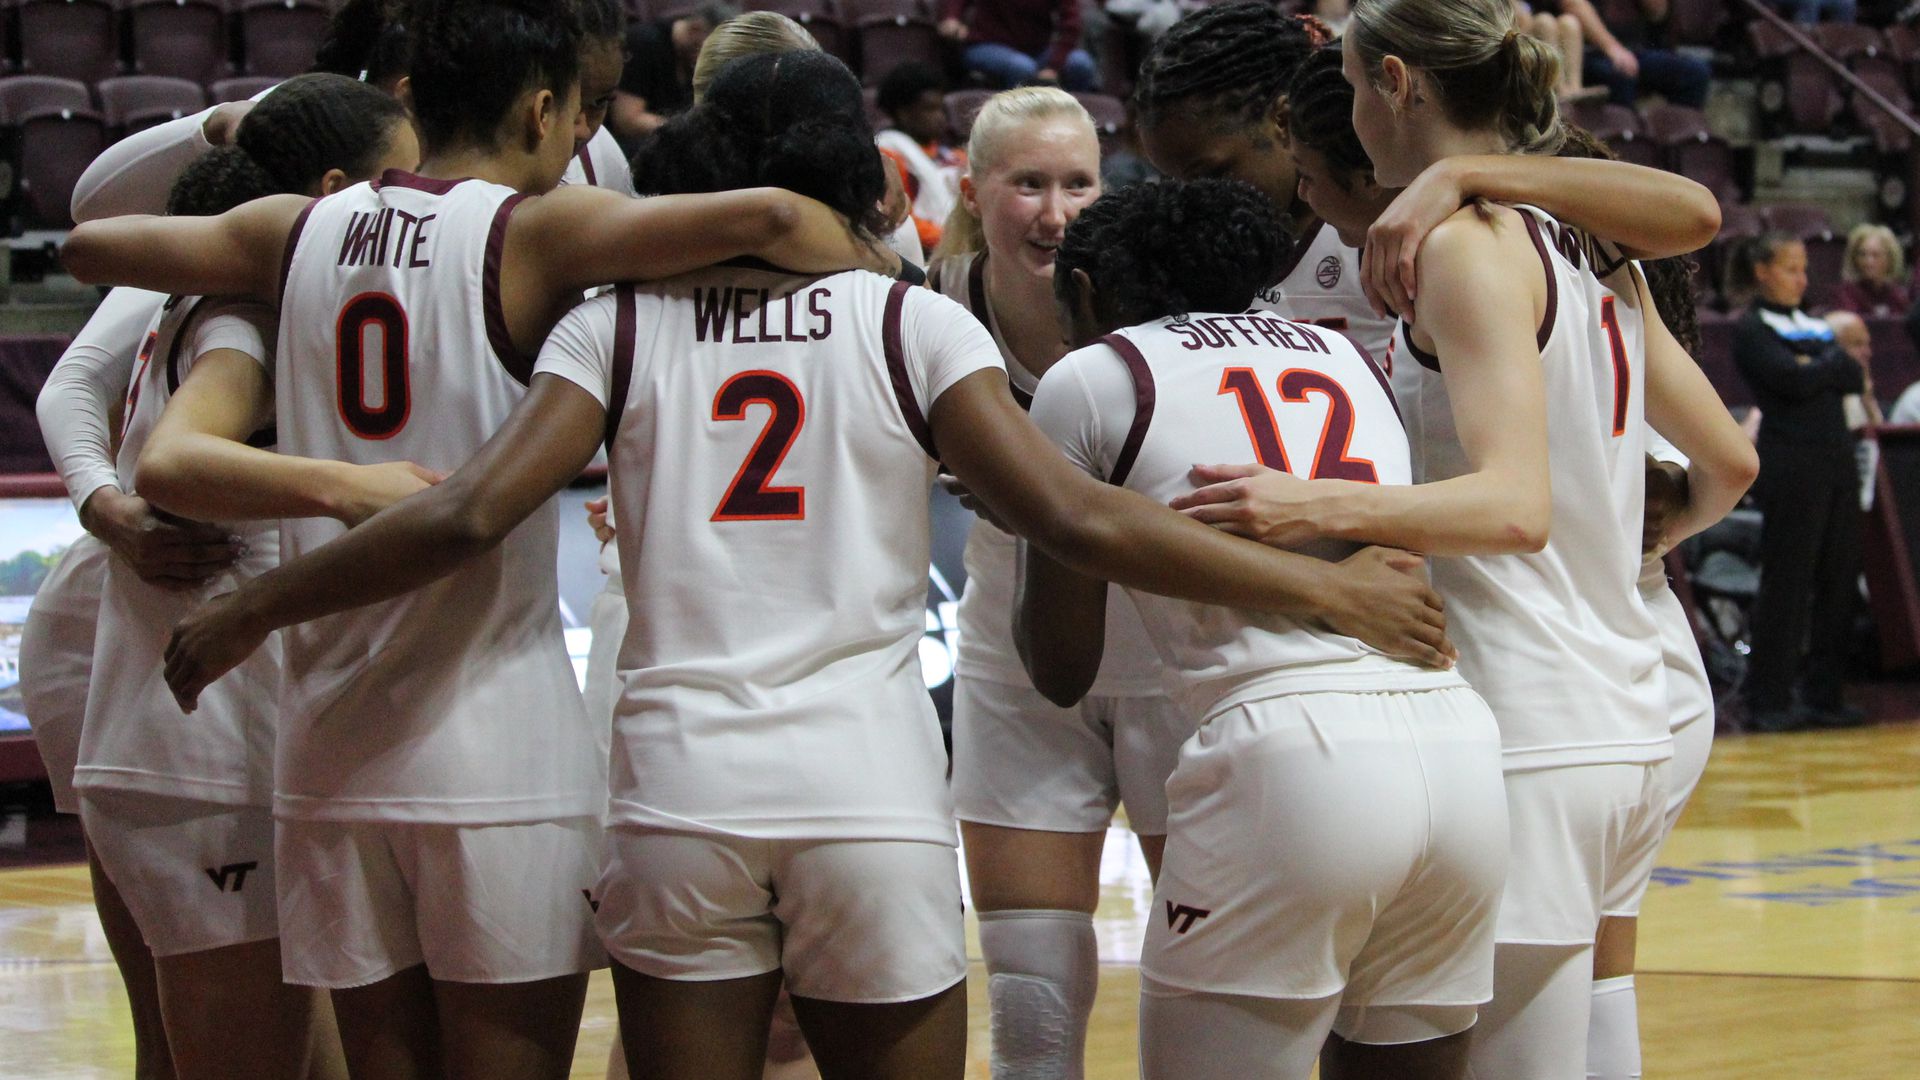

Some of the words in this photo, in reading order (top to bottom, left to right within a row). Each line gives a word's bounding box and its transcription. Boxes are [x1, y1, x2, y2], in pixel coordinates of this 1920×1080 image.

[337, 208, 437, 268] WHITE
[694, 287, 832, 344] WELLS
[1165, 316, 1331, 355] SUFFREN
[336, 291, 412, 441] 0
[1601, 295, 1630, 438] 1
[709, 369, 806, 522] 2
[1217, 367, 1380, 485] 12
[205, 861, 258, 893] VT
[1166, 899, 1212, 935] VT
